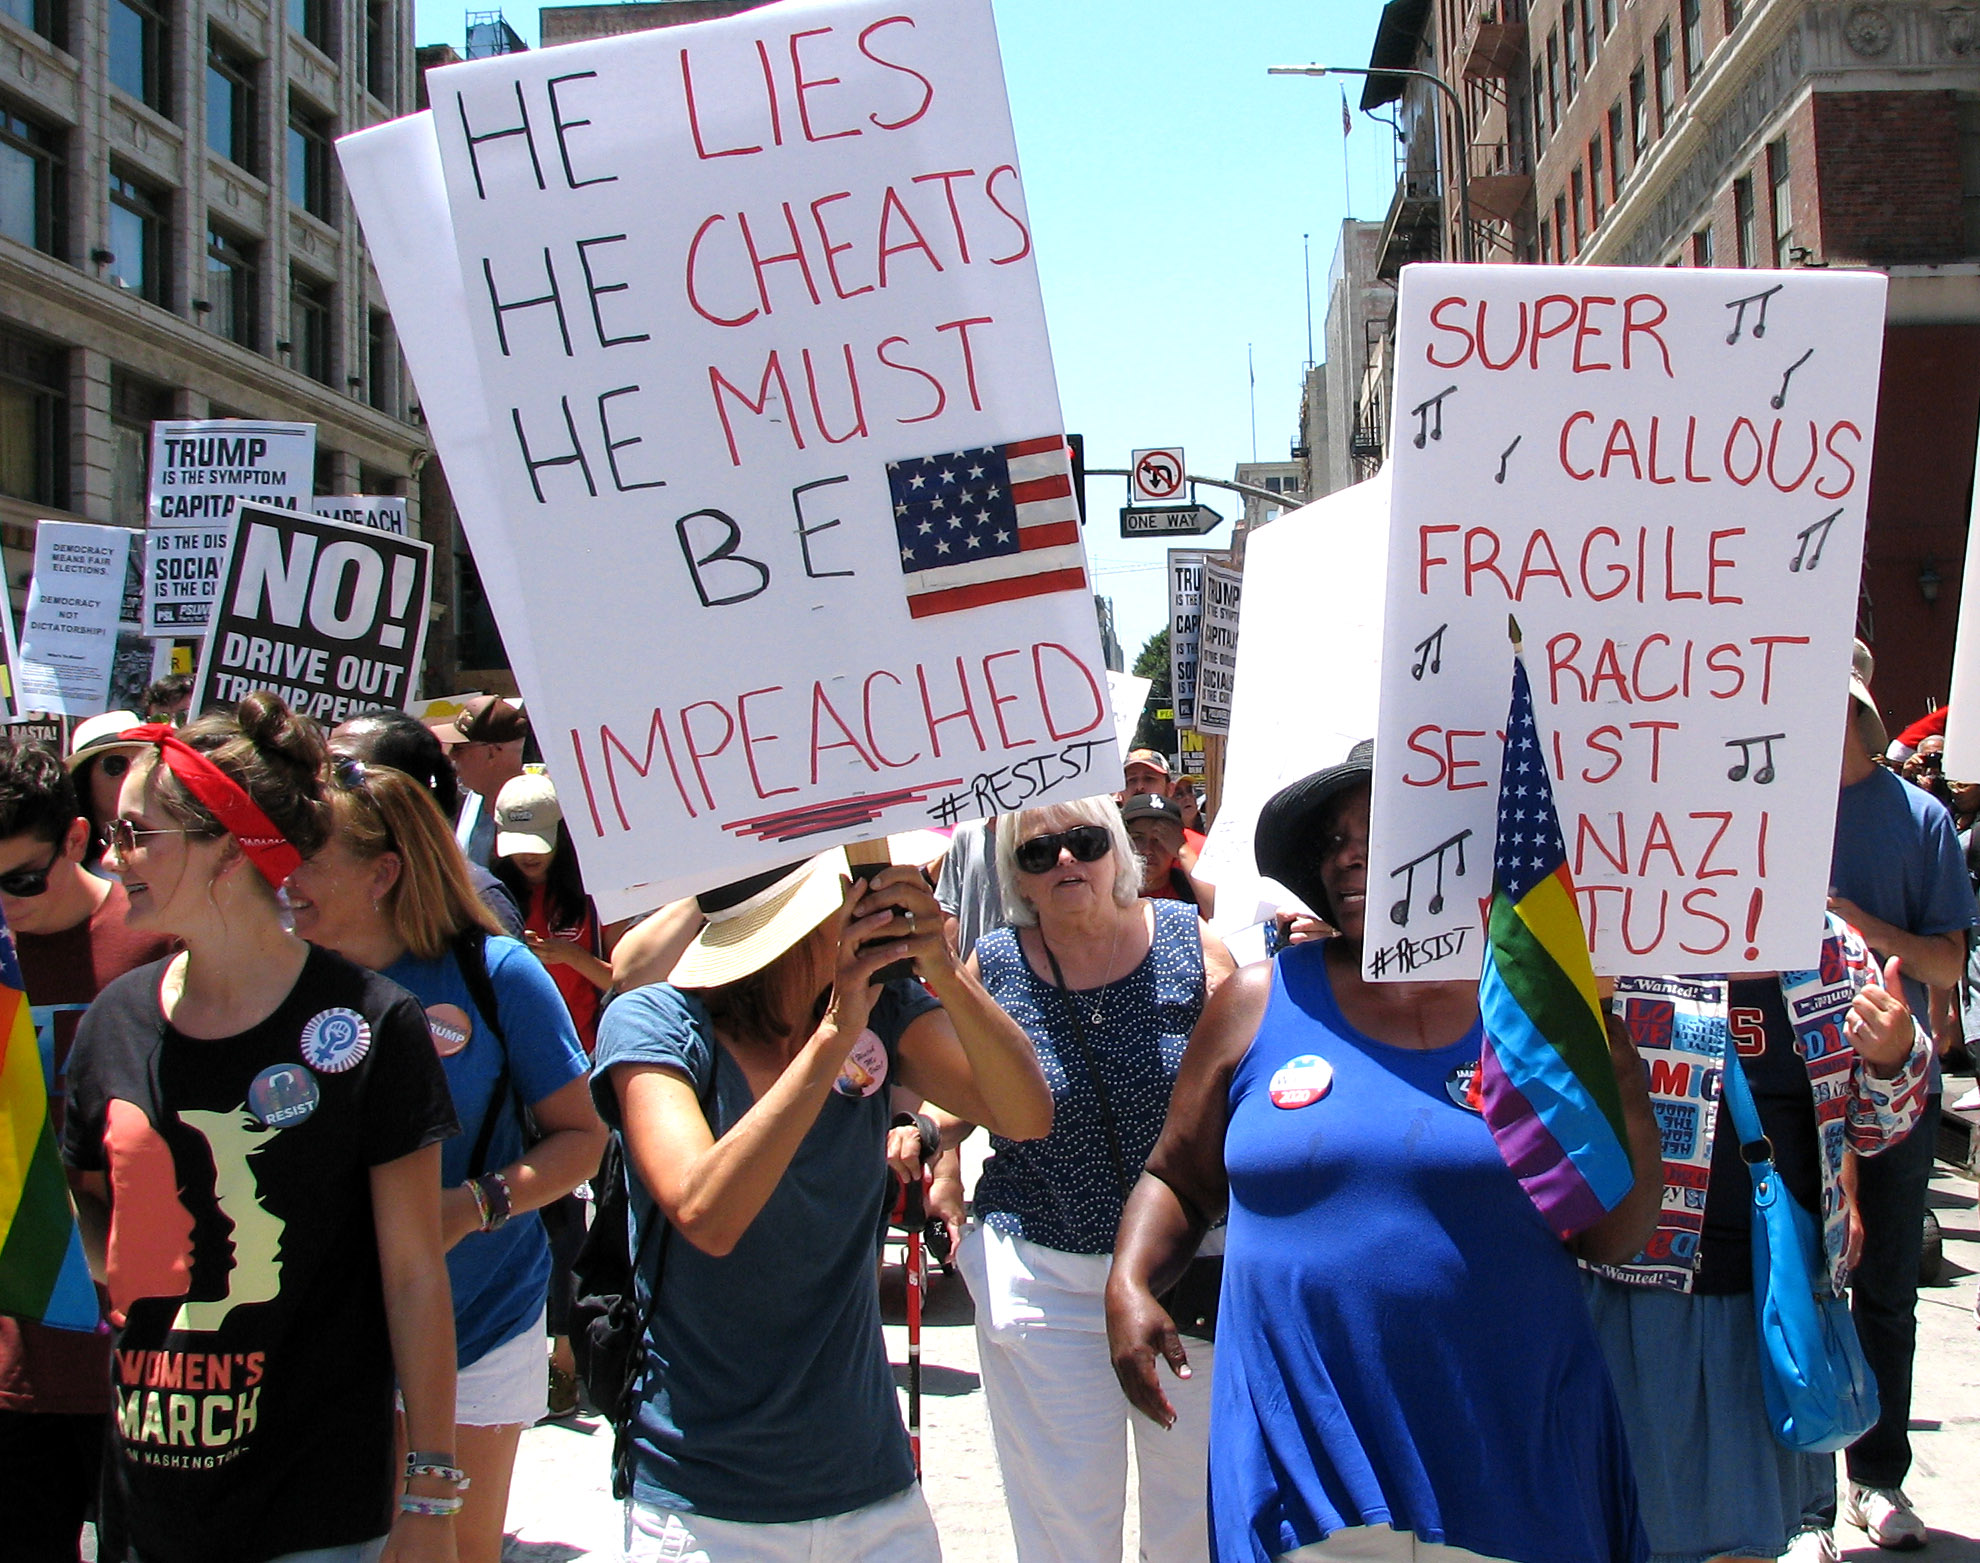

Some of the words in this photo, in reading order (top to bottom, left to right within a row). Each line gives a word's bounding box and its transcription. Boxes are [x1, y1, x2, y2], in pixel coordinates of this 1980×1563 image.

[457, 71, 619, 200] HE
[680, 15, 934, 160] LIES
[483, 233, 651, 357] HE
[686, 163, 1031, 328] CHEATS
[1426, 292, 1675, 379] SUPER
[511, 384, 667, 503] HE
[708, 315, 994, 467] MUST
[162, 470, 176, 485] IS
[181, 470, 205, 485] THE
[209, 470, 287, 485] SYMPTOM
[164, 438, 267, 469] TRUMP
[1559, 409, 1862, 500] CALLOUS
[52, 543, 114, 556] DEMOCRACY
[157, 535, 170, 551] IS
[174, 535, 199, 550] THE
[675, 474, 856, 608] BE
[1128, 515, 1158, 529] ONE
[1167, 513, 1198, 528] WAY
[52, 554, 86, 564] MEANS
[87, 556, 111, 566] FAIR
[155, 582, 168, 597] IS
[174, 581, 197, 596] THE
[232, 522, 417, 649] NO!
[1418, 523, 1747, 606] FRAGILE
[31, 621, 106, 636] DICTATORSHIP!
[40, 594, 101, 608] DEMOCRACY
[58, 611, 79, 620] NOT
[221, 631, 330, 685] DRIVE
[336, 655, 404, 698] OUT
[1545, 631, 1811, 705] RACIST
[570, 641, 1105, 838] IMPEACHED
[1401, 720, 1680, 792] SEIST
[925, 737, 1116, 827] #RESIST
[1574, 810, 1769, 880] NAZI
[1367, 925, 1475, 979] #RESIST
[1478, 886, 1765, 961] TUS!
[1634, 978, 1699, 998] Wanted!
[264, 1100, 316, 1125] RESIST
[1278, 1090, 1311, 1104] 2020
[1602, 1264, 1663, 1284] Wanted!
[114, 1348, 266, 1391] WOMEN'S
[116, 1384, 262, 1447] MARCH
